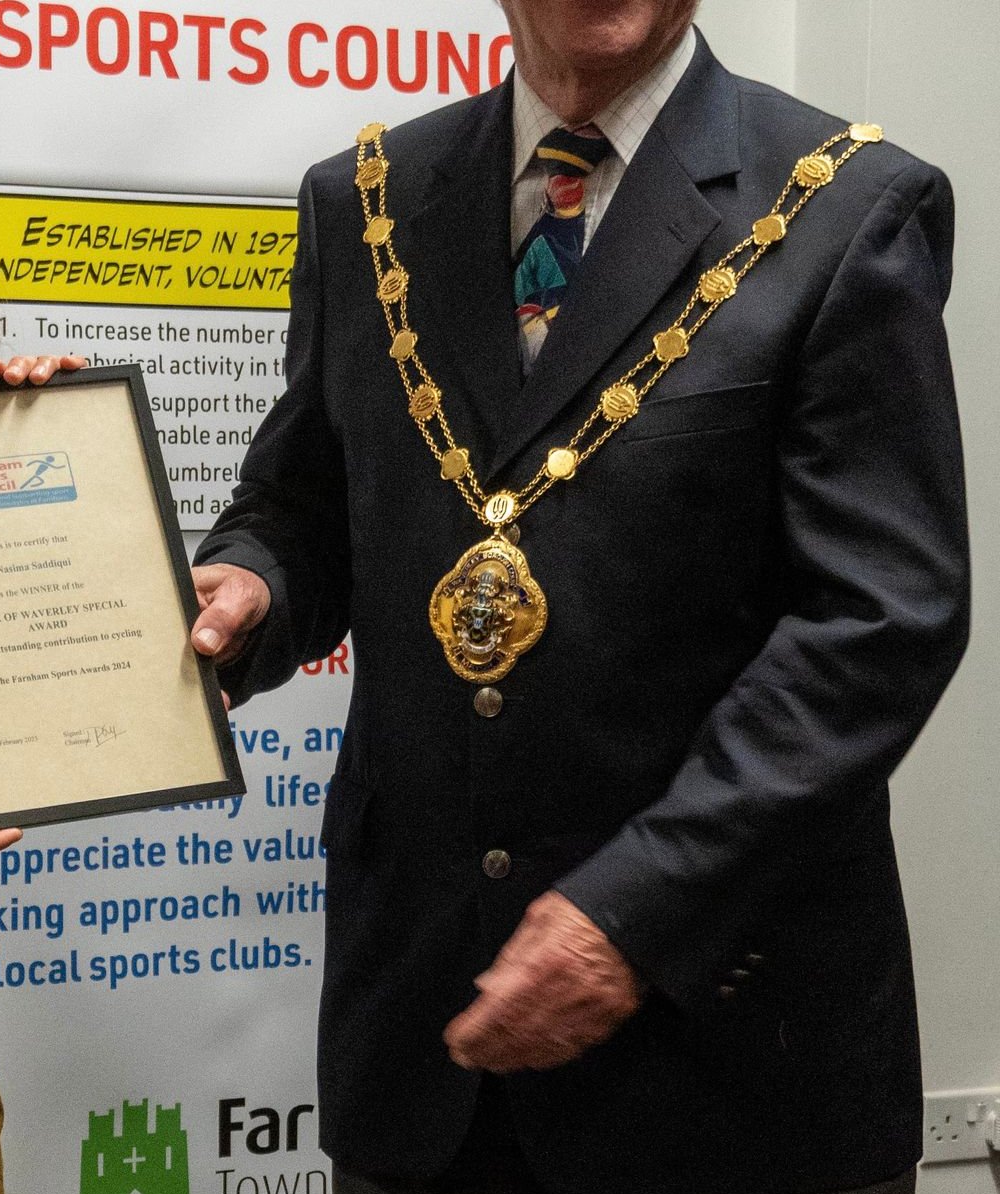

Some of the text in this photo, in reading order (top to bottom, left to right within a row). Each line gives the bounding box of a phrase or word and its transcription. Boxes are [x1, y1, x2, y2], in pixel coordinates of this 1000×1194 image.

[210, 231, 238, 255] IN
[245, 231, 298, 256] 197
[35, 317, 59, 339] To
[65, 318, 151, 341] increase
[158, 321, 190, 342] the
[197, 324, 275, 345] number
[170, 354, 267, 381] activity in
[151, 393, 230, 418] support
[235, 393, 267, 413] the
[216, 425, 252, 446] and
[5, 542, 12, 550] is
[23, 536, 50, 548] certify
[51, 535, 68, 544] that
[31, 557, 72, 570] Saddiqui
[6, 588, 19, 598] the
[19, 583, 60, 596] WINNER
[61, 582, 70, 592] of
[71, 581, 85, 591] the
[3, 612, 19, 623] OF
[20, 604, 80, 621] WAVERLEY
[82, 599, 127, 613] SPECIAL
[28, 619, 68, 633] AWARD
[43, 633, 98, 648] contribution
[100, 632, 110, 642] to
[111, 628, 143, 641] cycling
[11, 672, 50, 684] Farnham
[50, 668, 78, 681] Sports
[79, 663, 111, 676] Awards
[111, 660, 132, 671] 2024
[176, 833, 233, 866] the
[79, 885, 241, 935] approach
[255, 880, 326, 916] with
[89, 945, 201, 990] sports
[210, 937, 313, 972] clubs.
[219, 1097, 315, 1158] Far
